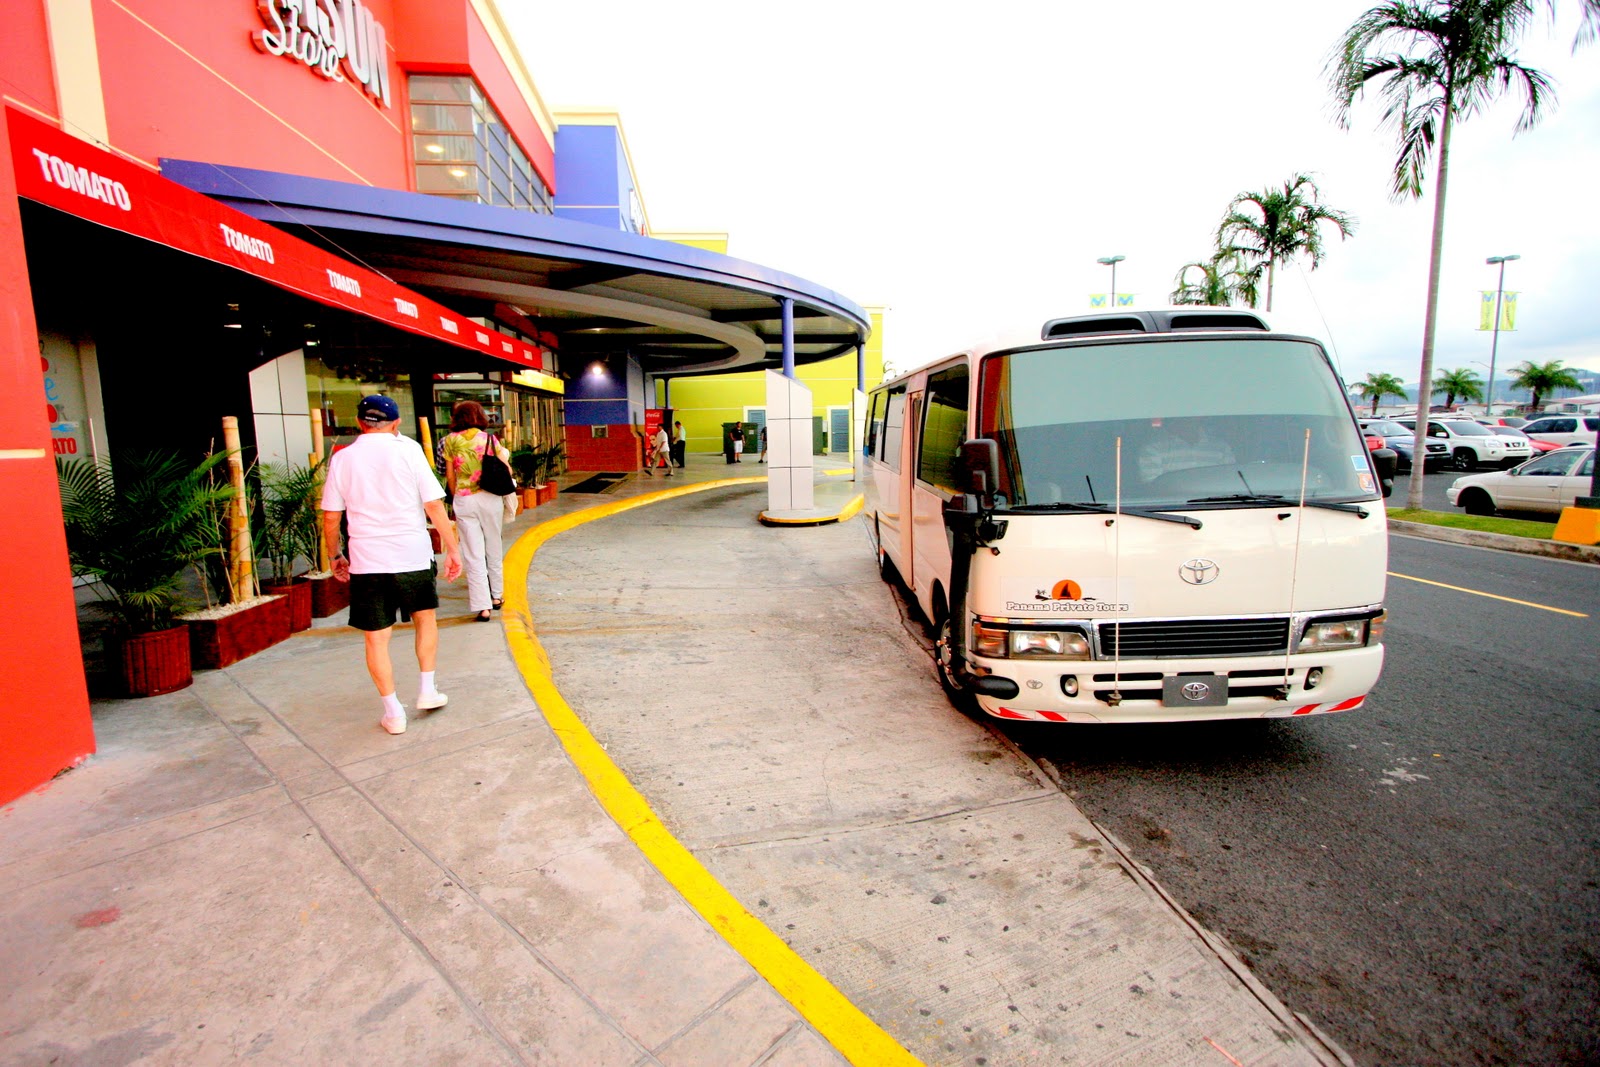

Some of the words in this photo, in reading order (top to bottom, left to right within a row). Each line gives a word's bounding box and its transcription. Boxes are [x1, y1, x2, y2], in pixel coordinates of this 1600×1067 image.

[262, 0, 344, 82] Store
[32, 147, 132, 211] TOMATO
[220, 223, 275, 264] TOMATO
[326, 268, 362, 298] TOMATO
[1006, 601, 1051, 612] Panama
[1052, 602, 1095, 612] Private
[1096, 602, 1129, 612] Tours
